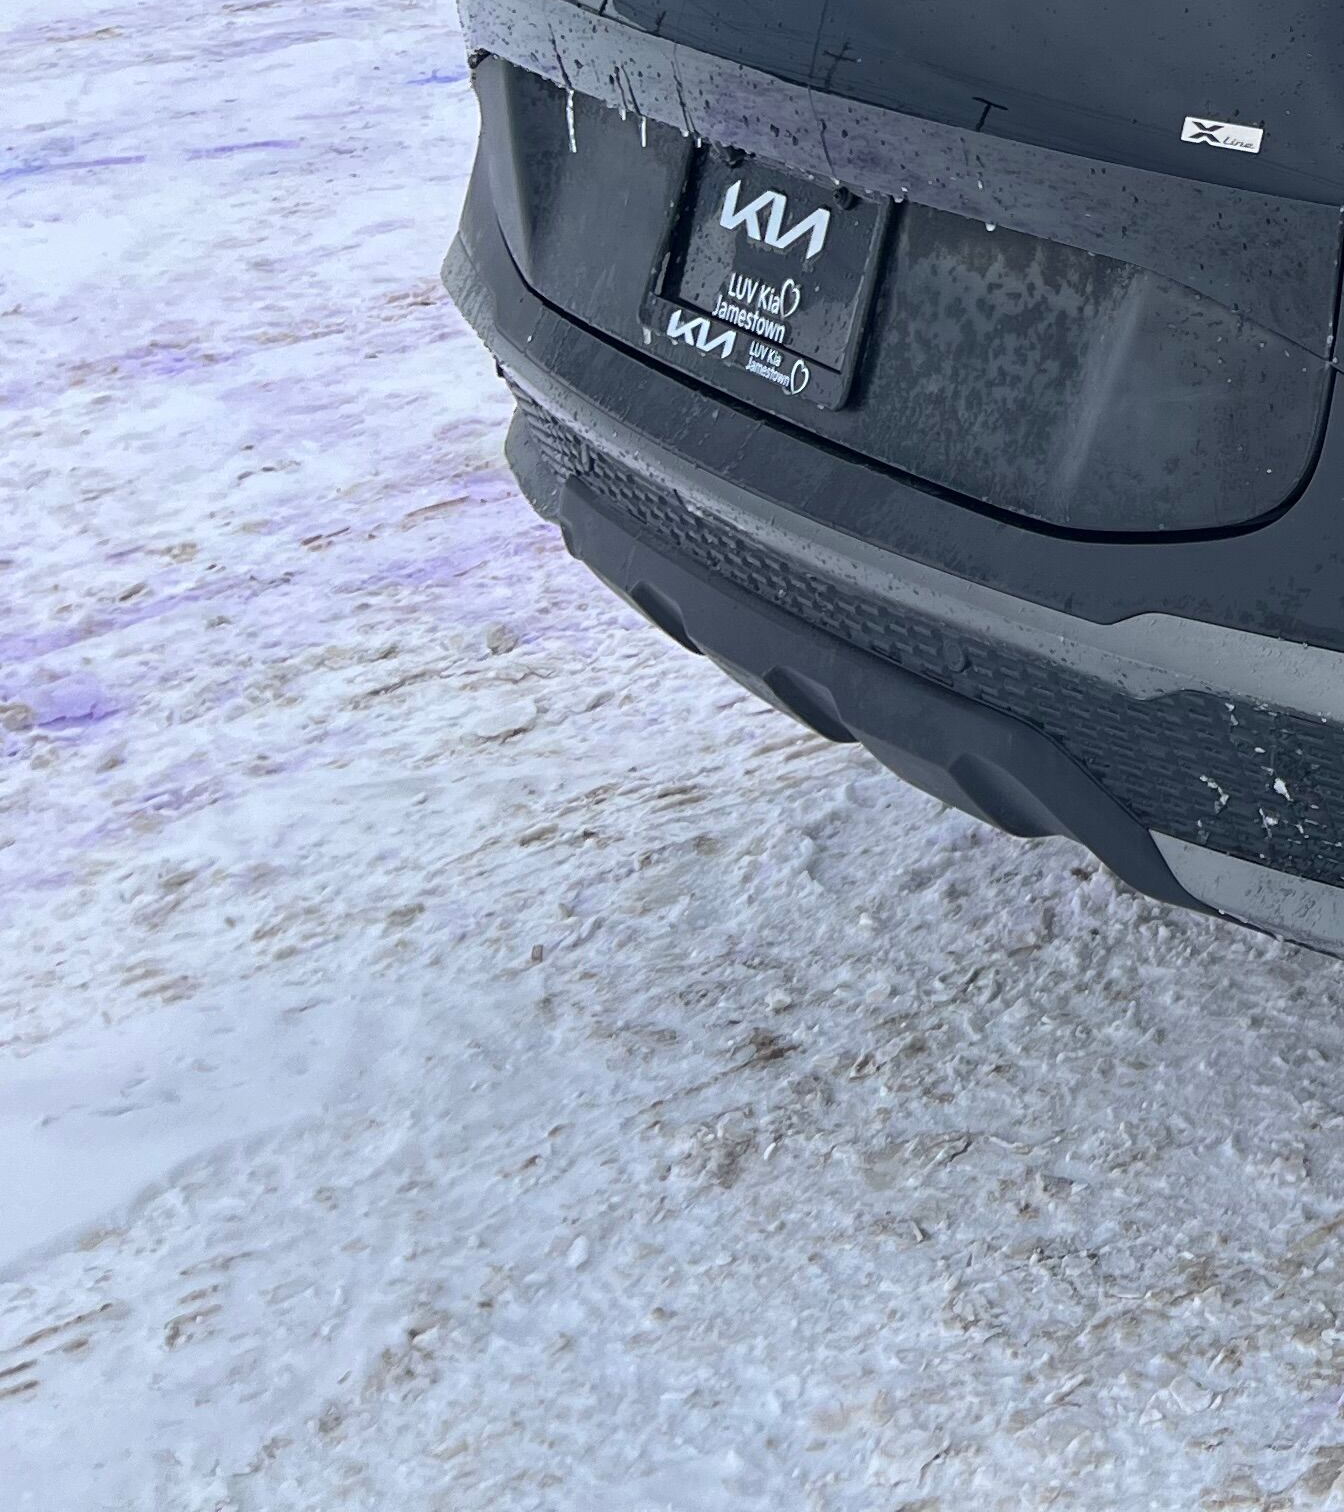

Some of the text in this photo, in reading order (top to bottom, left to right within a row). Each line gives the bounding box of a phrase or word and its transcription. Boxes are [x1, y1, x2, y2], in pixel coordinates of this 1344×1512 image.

[728, 272, 782, 315] LUV Kia
[711, 294, 786, 344] Jamestown
[748, 340, 770, 361] LUV
[745, 355, 791, 388] Jamestown
